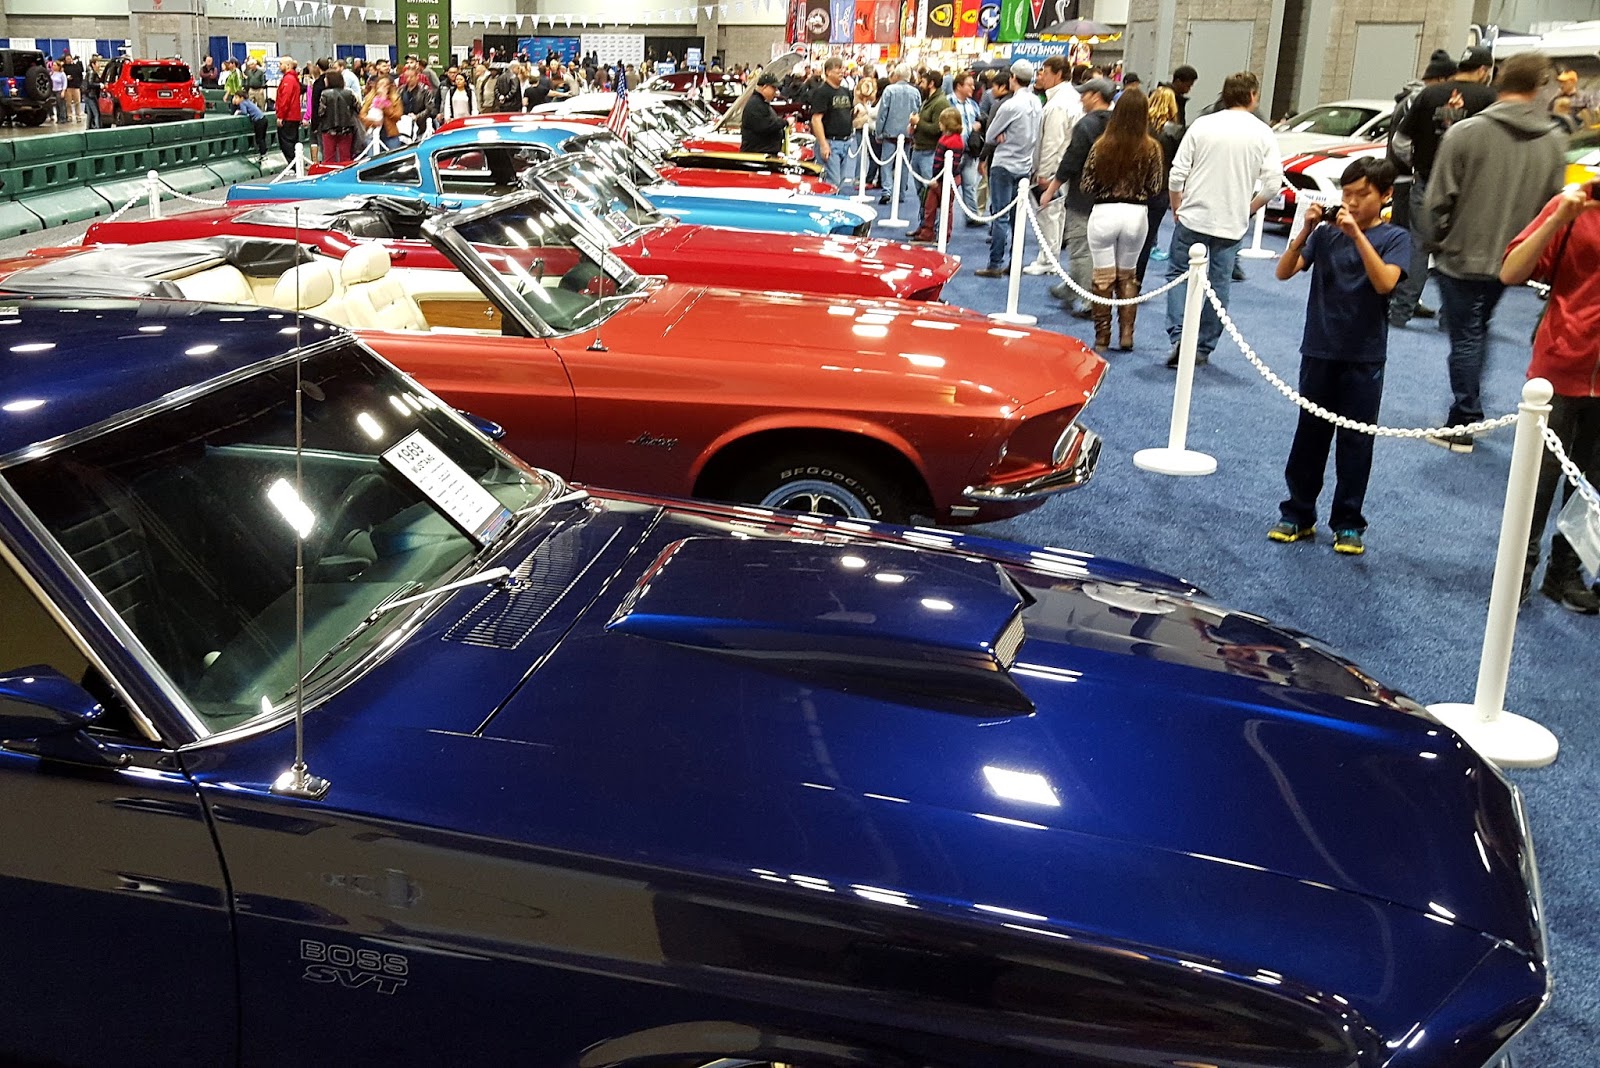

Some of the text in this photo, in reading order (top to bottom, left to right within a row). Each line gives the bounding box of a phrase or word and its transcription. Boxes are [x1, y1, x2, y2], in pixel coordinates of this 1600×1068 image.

[397, 442, 424, 463] 1969
[300, 939, 409, 975] BOSS
[302, 965, 408, 995] SVT
